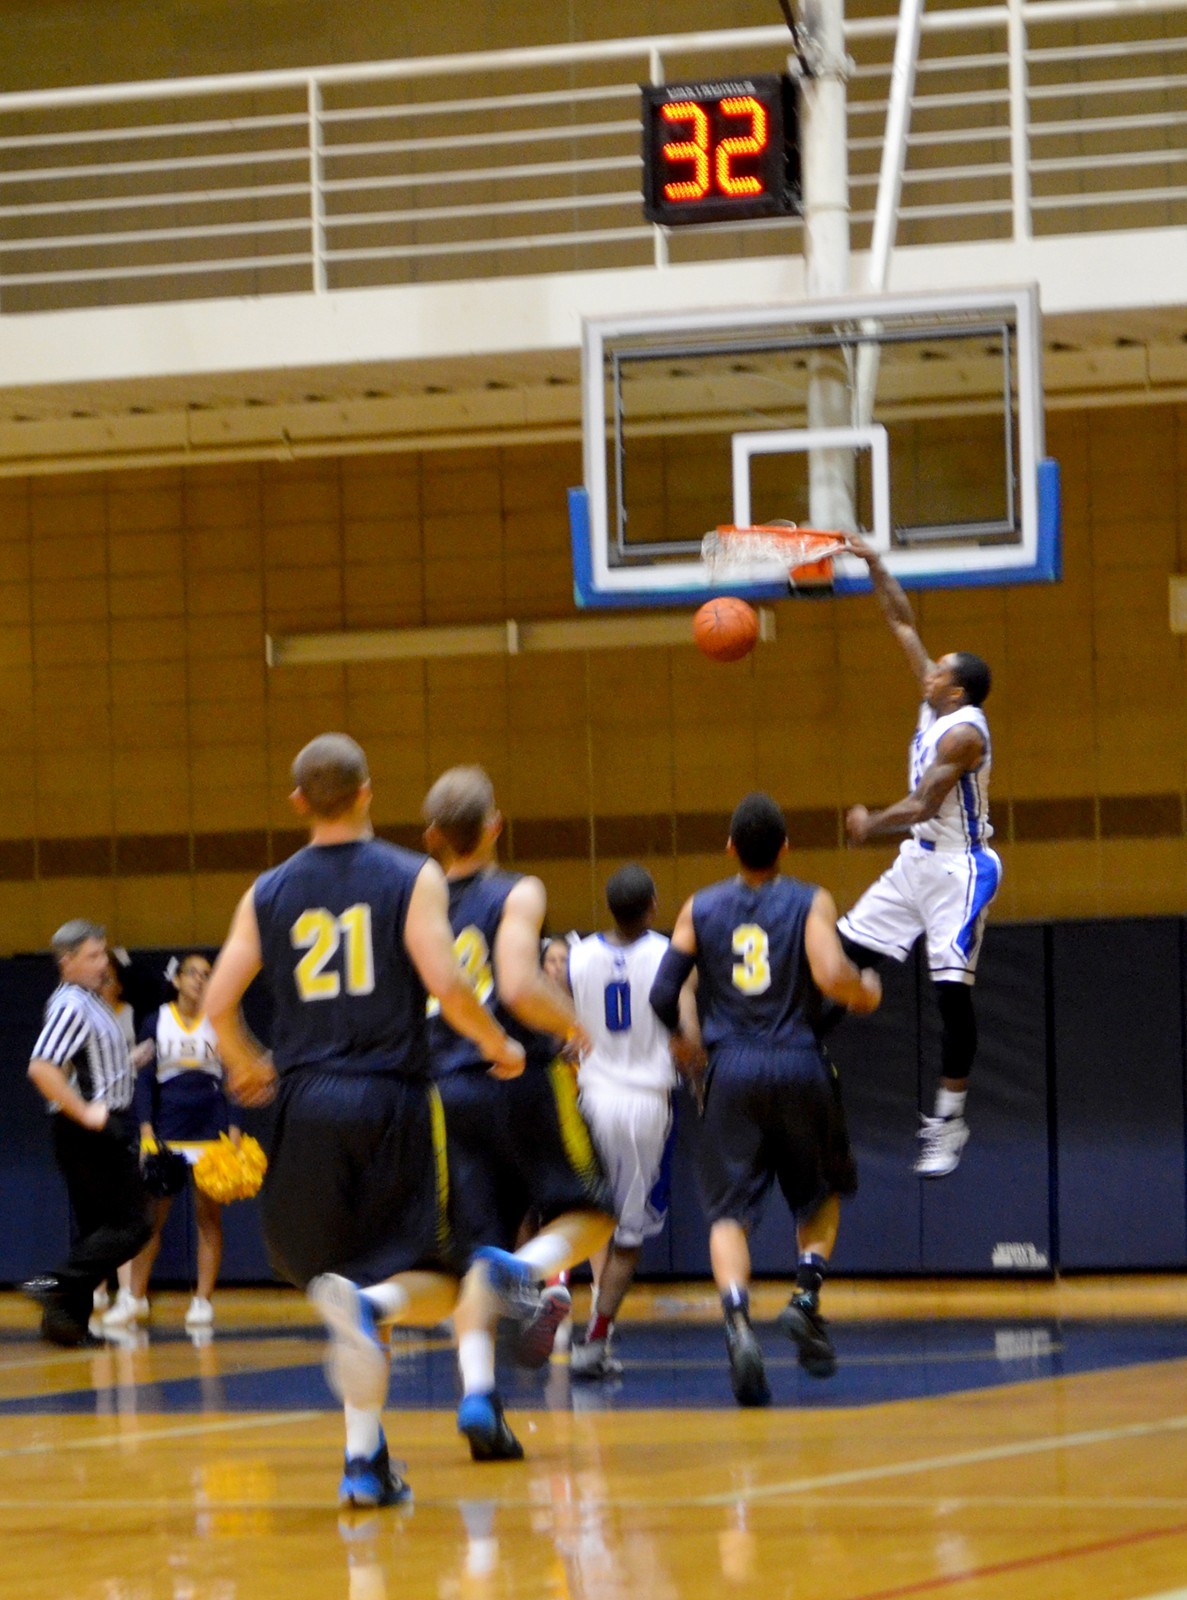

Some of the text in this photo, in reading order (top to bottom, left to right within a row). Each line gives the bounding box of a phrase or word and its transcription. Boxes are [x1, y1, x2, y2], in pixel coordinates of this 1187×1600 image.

[662, 96, 767, 199] 32
[289, 902, 375, 1002] 21
[732, 923, 771, 996] 3
[604, 982, 632, 1031] 0
